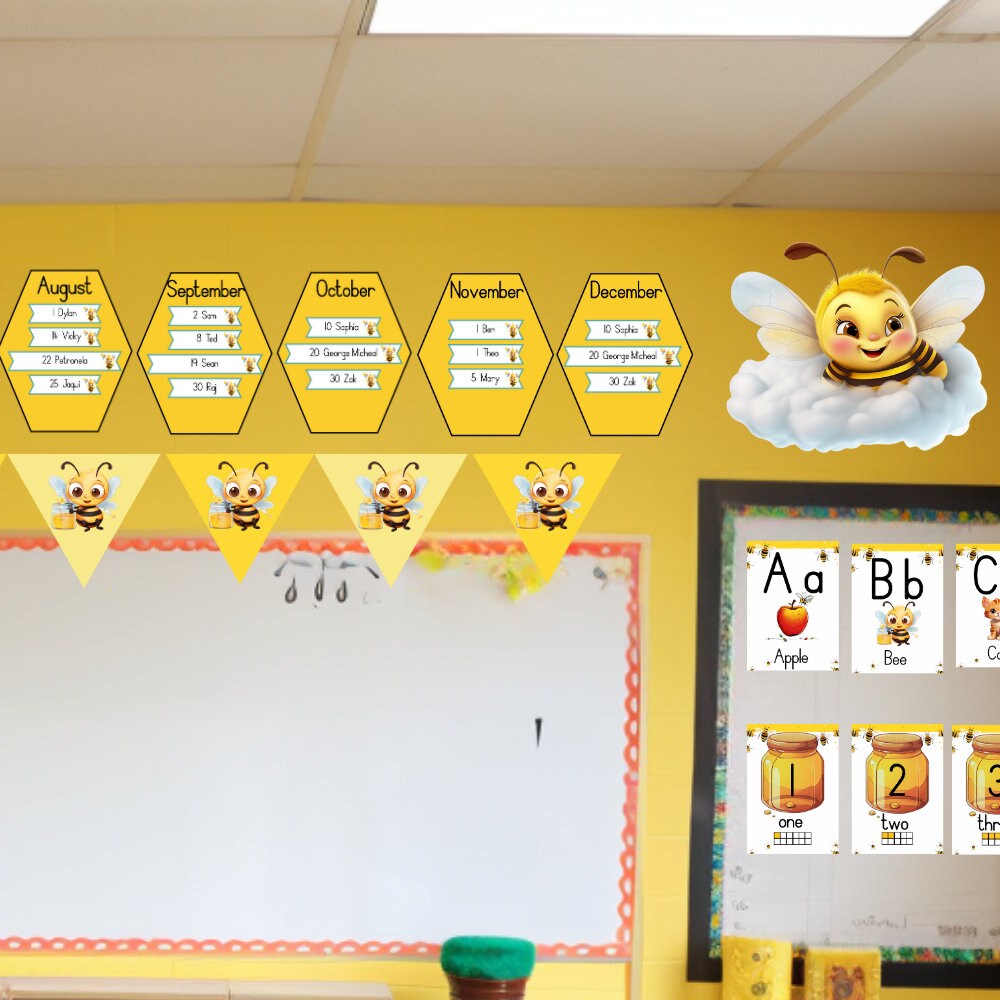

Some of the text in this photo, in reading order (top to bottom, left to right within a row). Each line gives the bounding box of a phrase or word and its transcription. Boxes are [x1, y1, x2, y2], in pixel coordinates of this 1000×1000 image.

[38, 276, 92, 302] August
[167, 279, 247, 305] September
[316, 279, 375, 297] October
[449, 280, 525, 298] November
[590, 280, 662, 298] December
[202, 311, 216, 319] Sam
[325, 322, 332, 330] 10
[604, 324, 611, 333] 10
[206, 334, 217, 342] Ted
[310, 348, 319, 356] 20
[483, 348, 499, 357] Theo
[589, 351, 599, 359] 20
[42, 355, 51, 364] 22
[202, 358, 218, 367] Sean
[330, 374, 340, 382] 30
[609, 377, 619, 385] 30
[50, 379, 58, 388] 25
[193, 382, 203, 391] 30
[764, 552, 823, 593] A a
[871, 557, 924, 600] B b
[774, 648, 808, 670] Apple
[885, 650, 907, 665] Bee
[888, 763, 907, 797] 2
[779, 819, 803, 828] one
[881, 813, 909, 830] two
